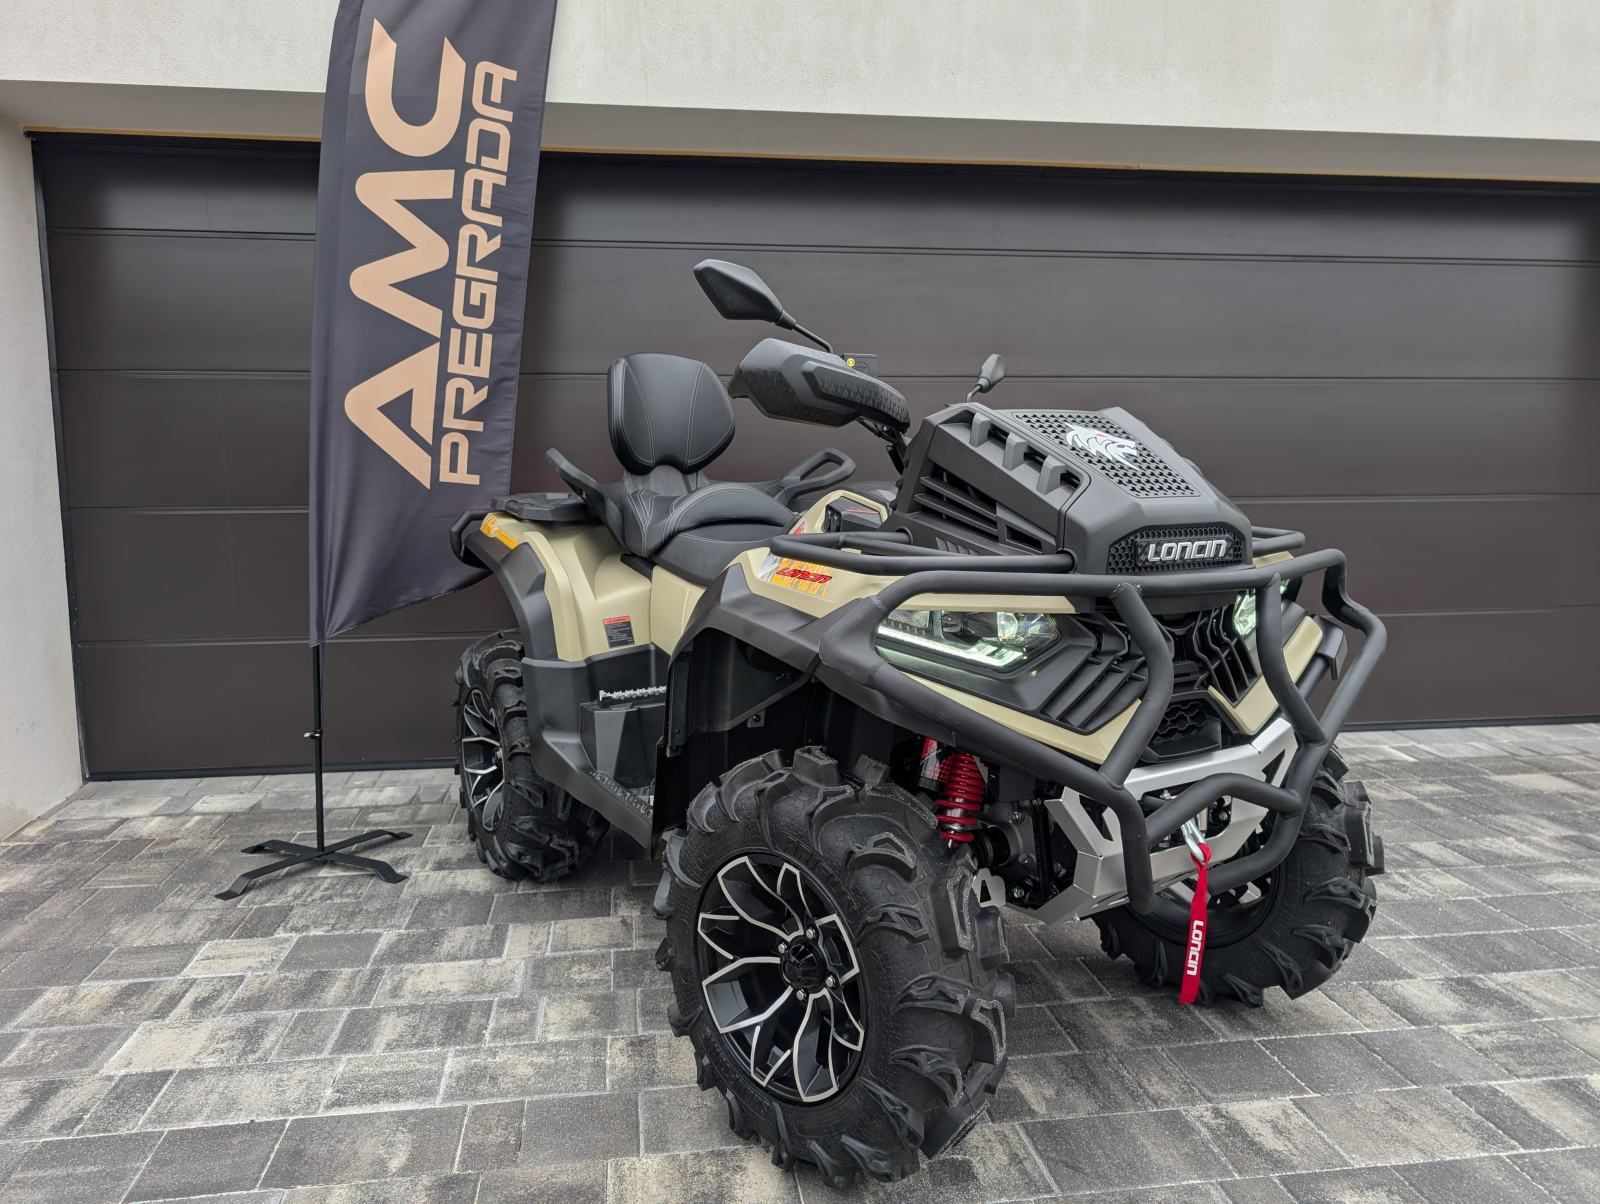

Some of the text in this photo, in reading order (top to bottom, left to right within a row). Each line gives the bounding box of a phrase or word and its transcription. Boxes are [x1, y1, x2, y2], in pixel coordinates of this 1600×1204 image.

[344, 17, 466, 490] AMC
[439, 60, 518, 486] PREGRADA
[1147, 539, 1227, 562] LONCIN
[1186, 919, 1204, 976] LONCIN
